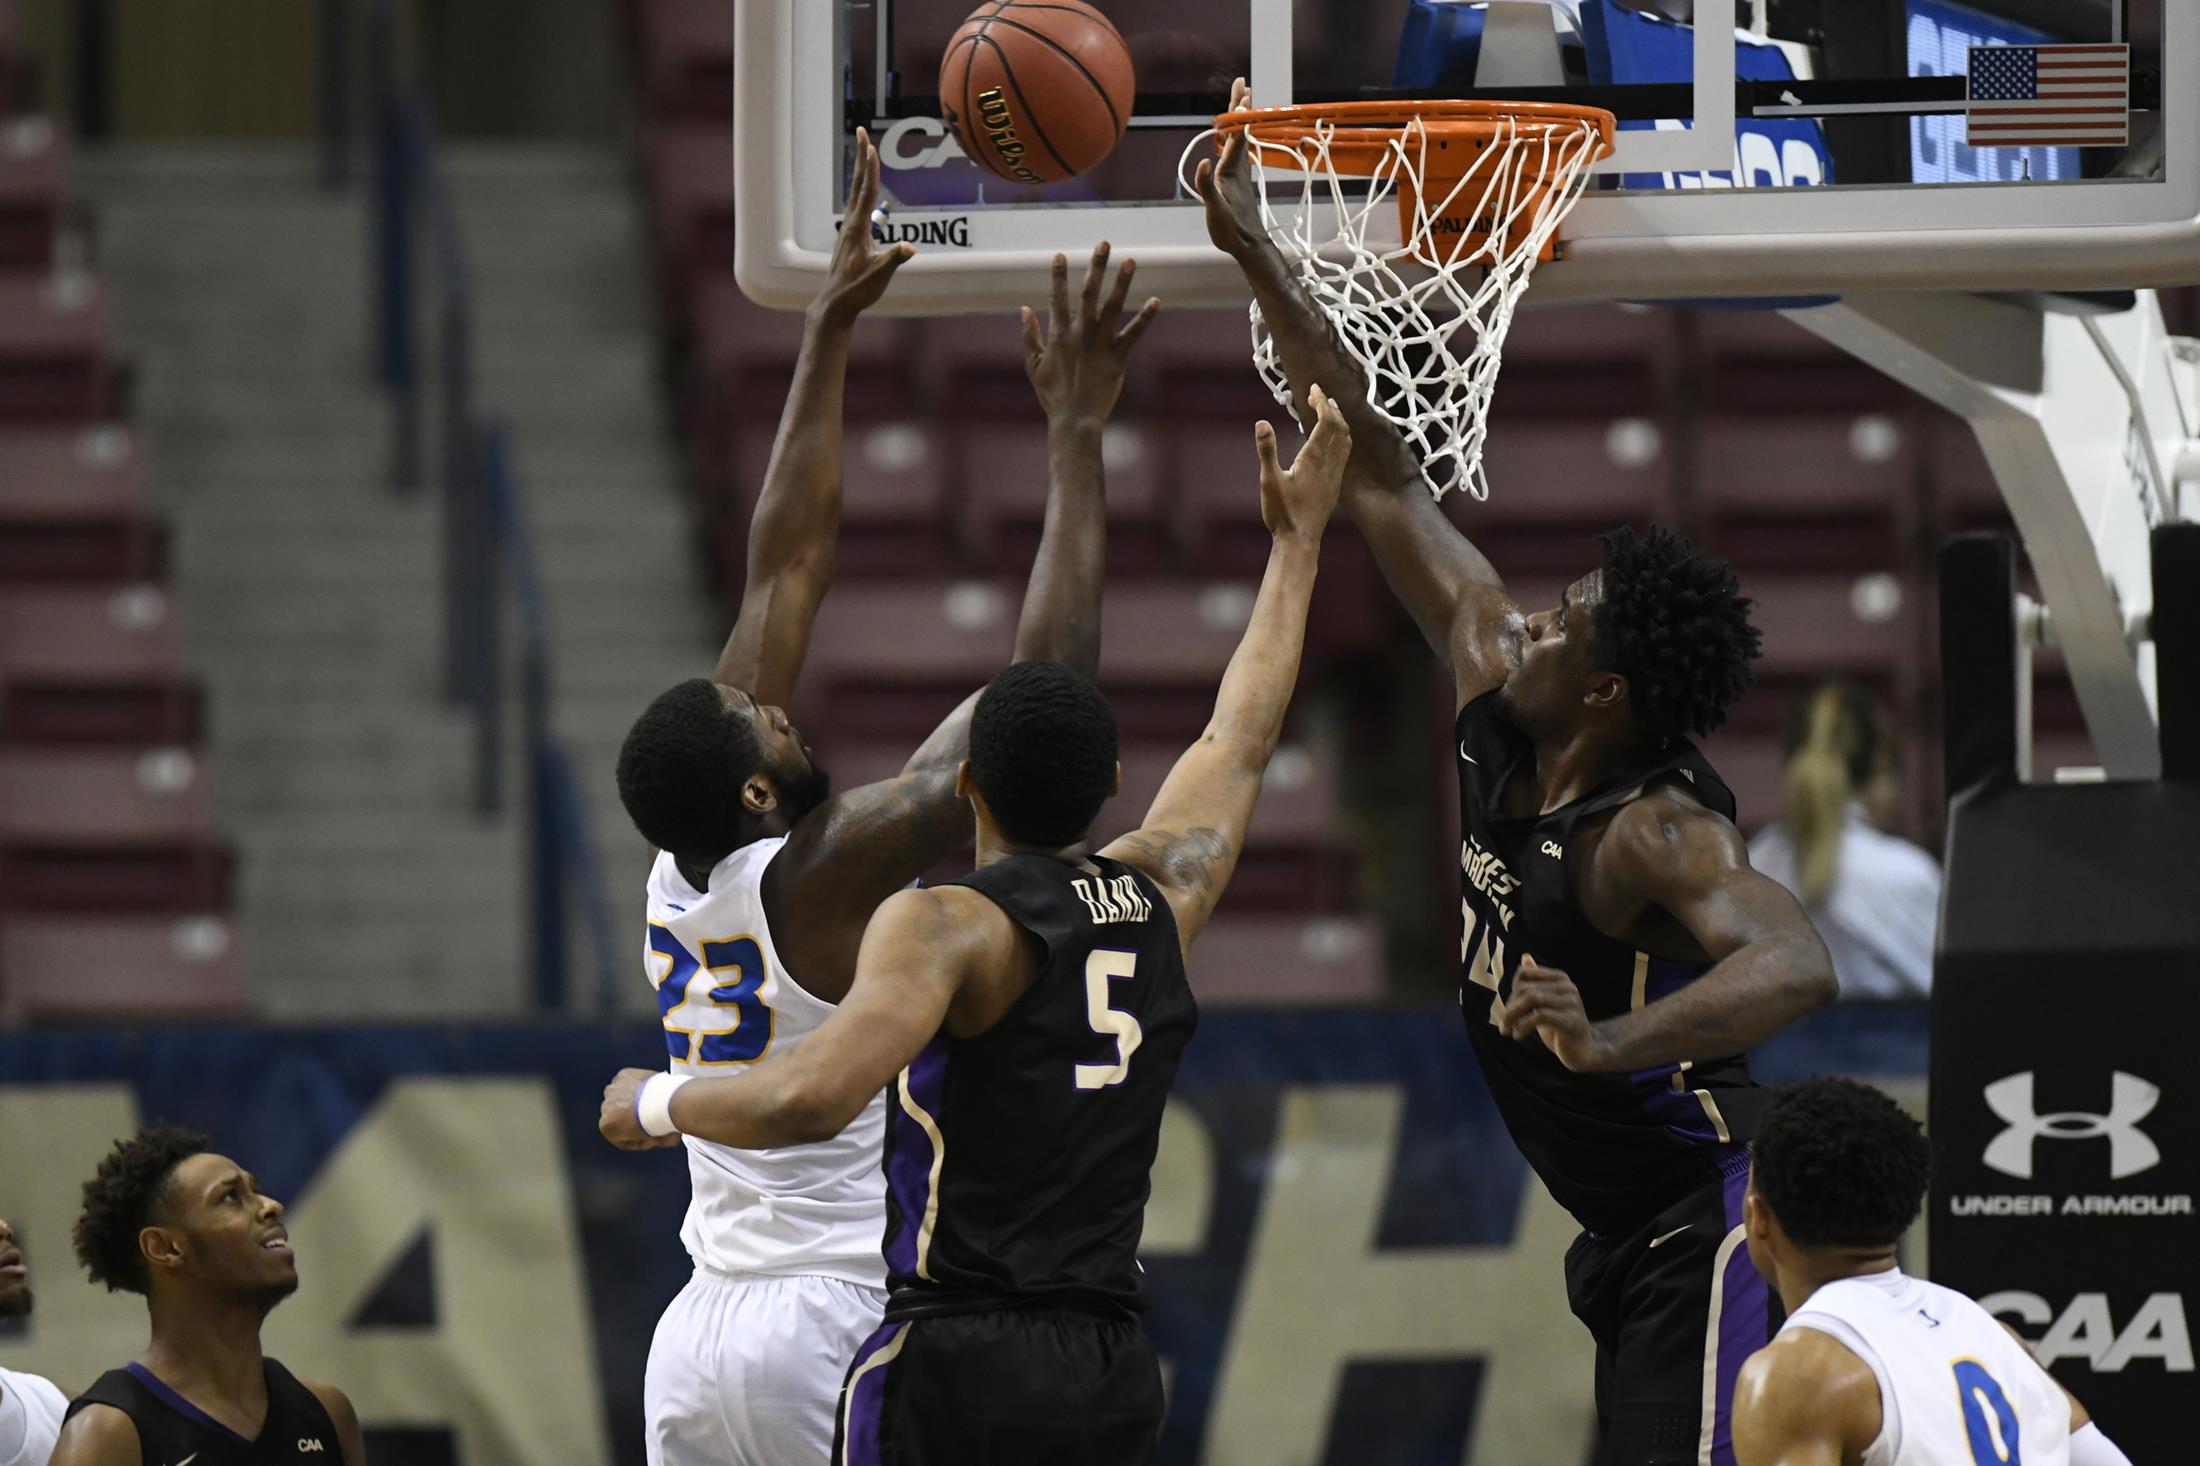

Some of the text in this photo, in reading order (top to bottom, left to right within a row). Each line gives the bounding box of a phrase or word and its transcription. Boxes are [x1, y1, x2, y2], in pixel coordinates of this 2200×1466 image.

[878, 115, 978, 170] CA
[1540, 839, 1563, 861] CAA
[648, 918, 776, 1067] 23
[1074, 948, 1144, 1091] 5
[1950, 1195, 2191, 1216] UNDER ARMOUR
[1949, 1355, 2022, 1466] 0
[297, 1438, 324, 1452] CAA
